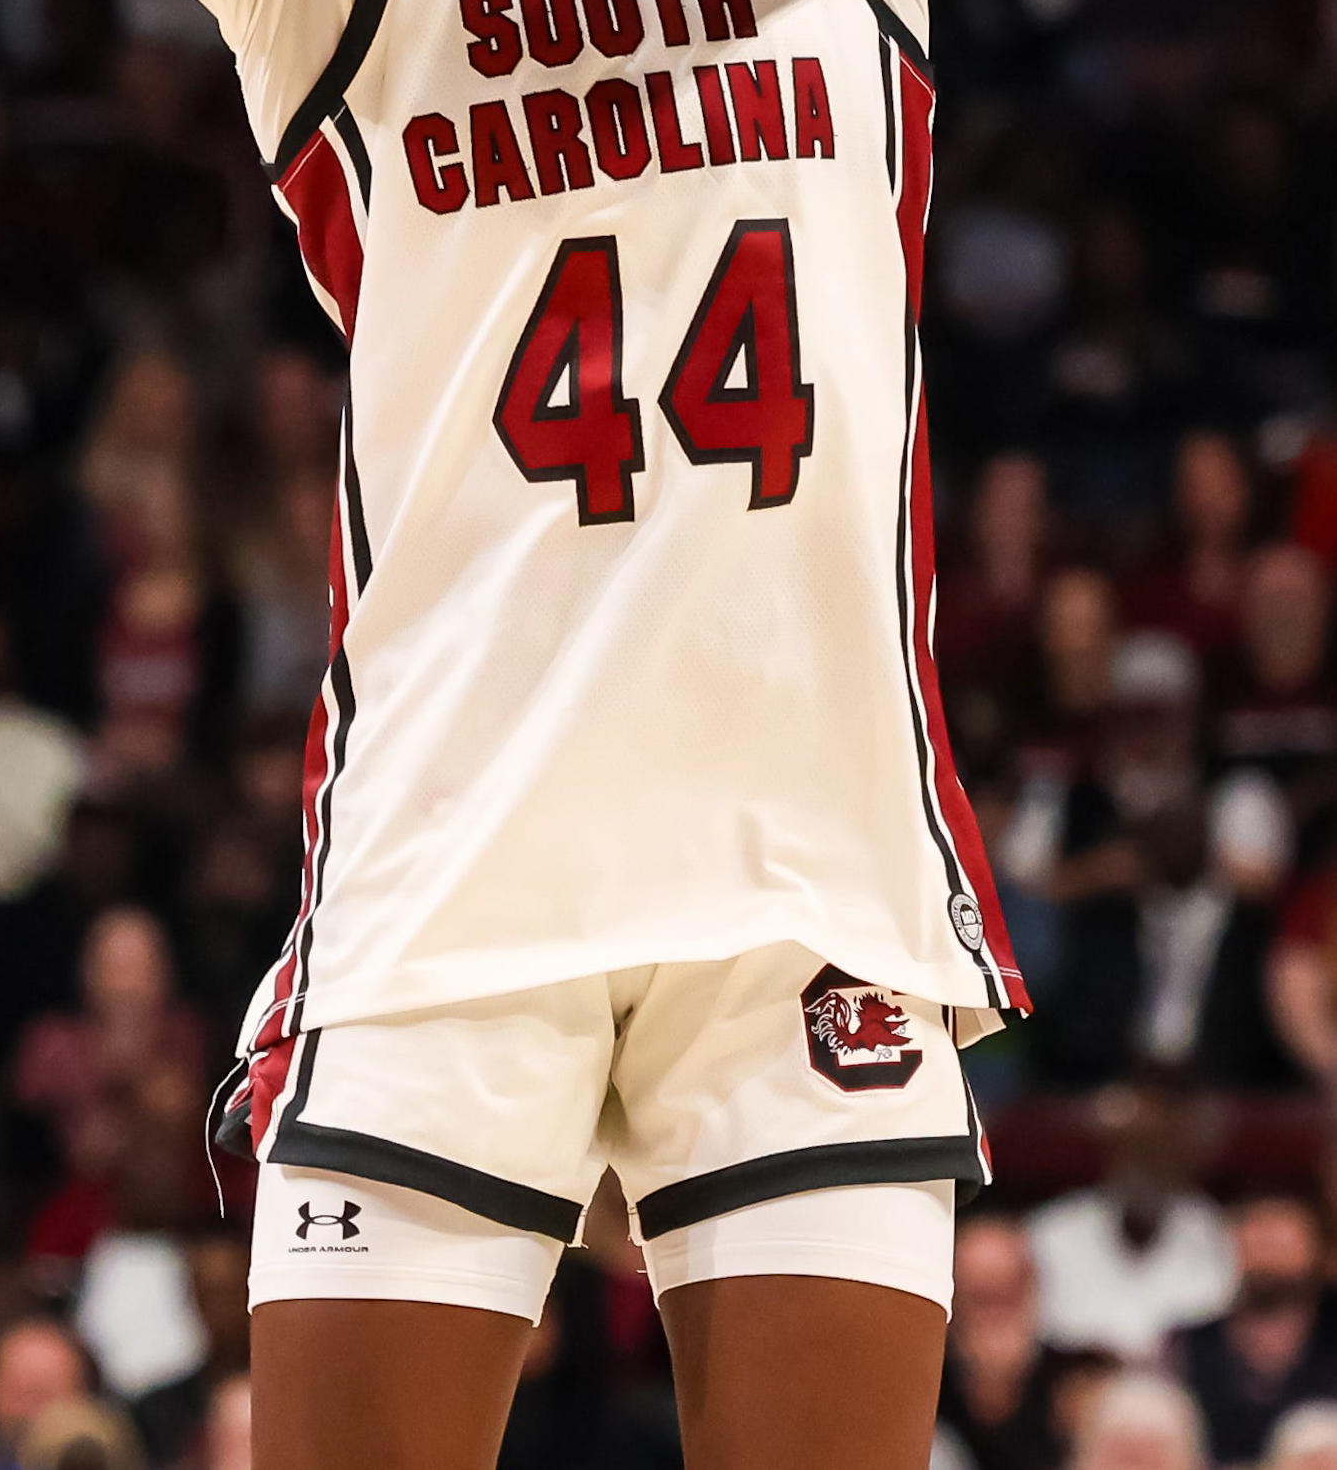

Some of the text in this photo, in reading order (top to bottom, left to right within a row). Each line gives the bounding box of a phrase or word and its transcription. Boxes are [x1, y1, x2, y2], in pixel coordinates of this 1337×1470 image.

[402, 57, 836, 215] CAROLINA
[492, 217, 815, 527] 44
[319, 1245, 370, 1253] ARMOUR
